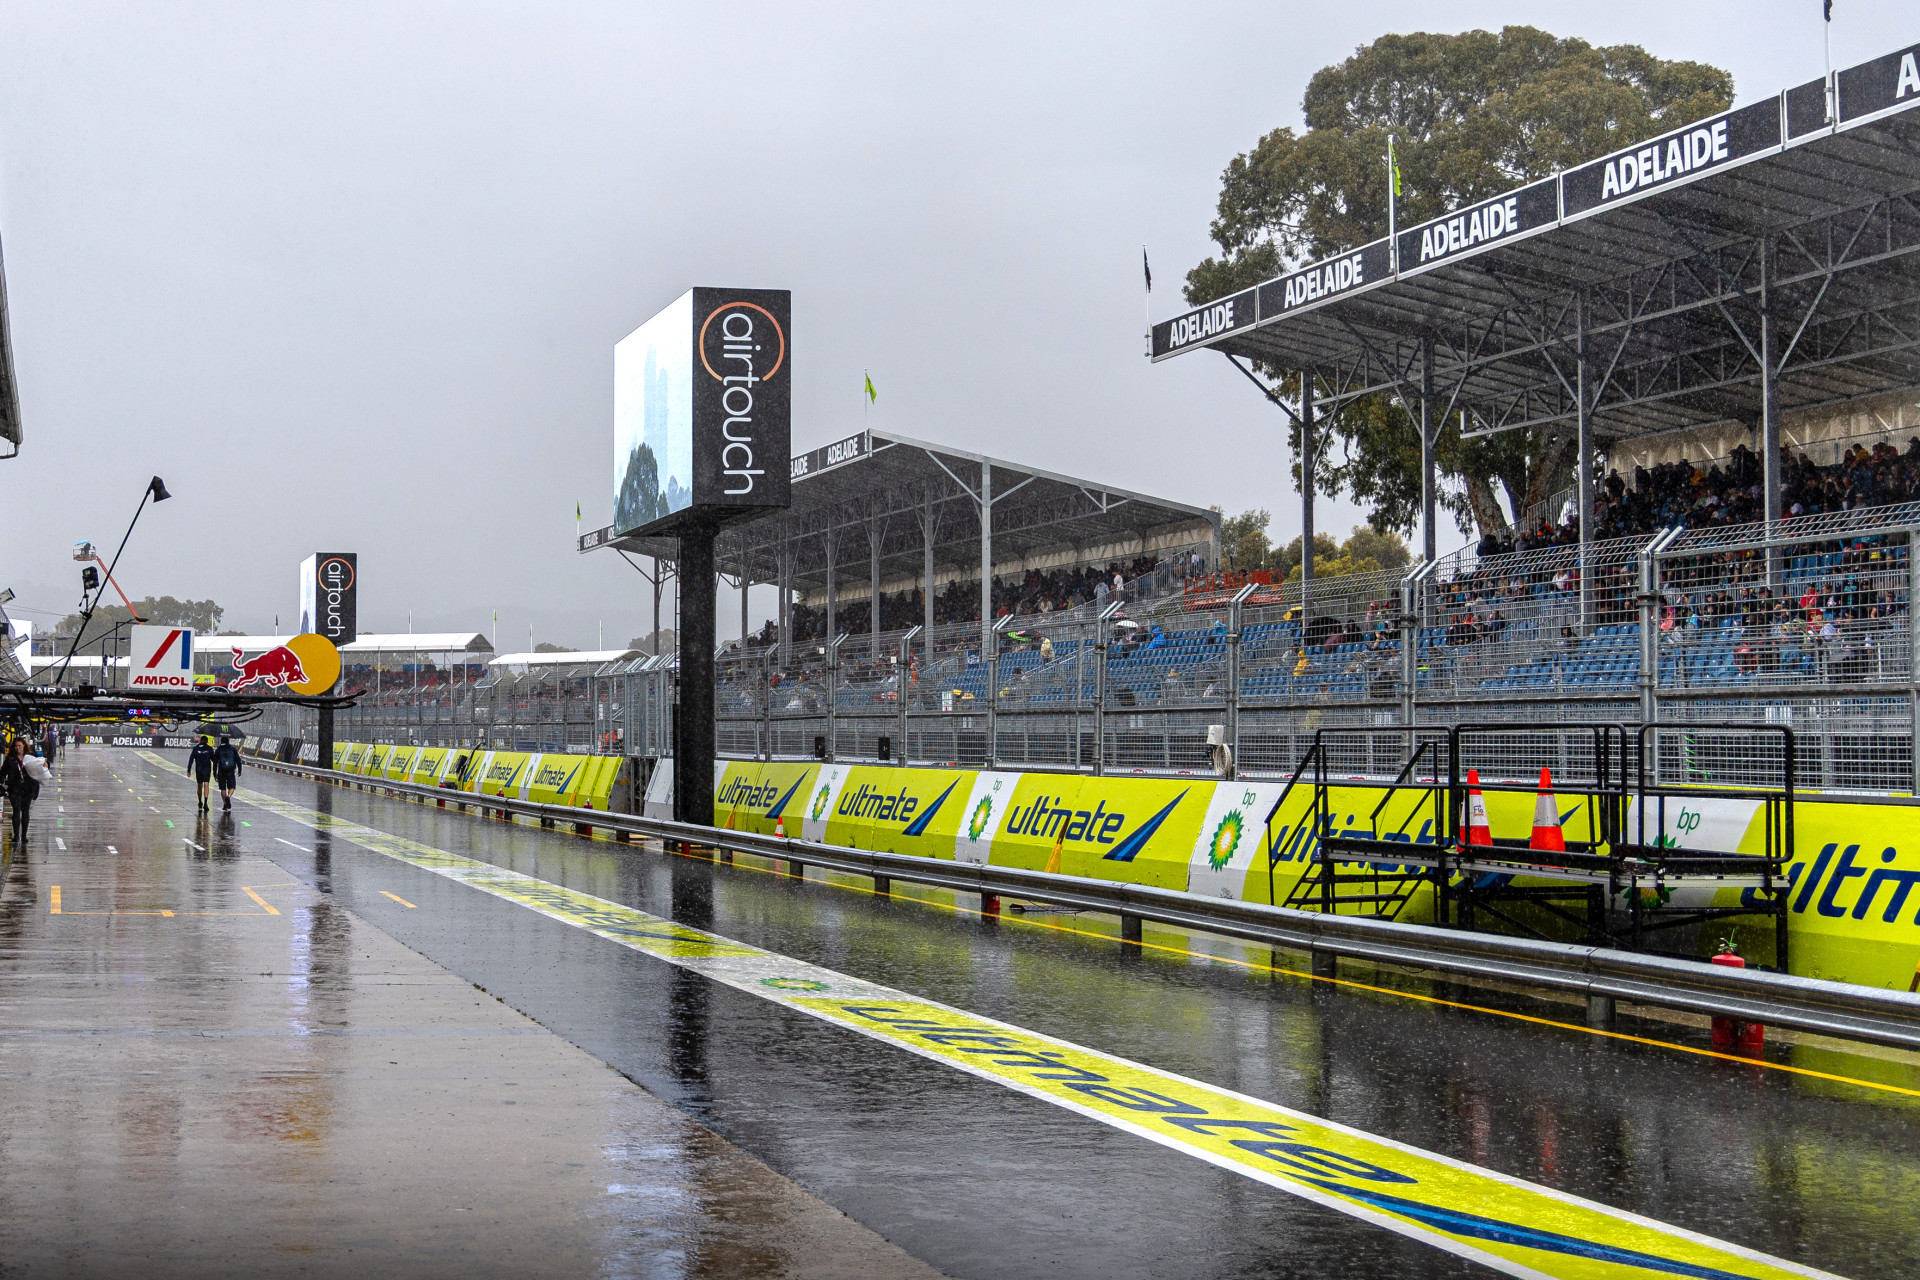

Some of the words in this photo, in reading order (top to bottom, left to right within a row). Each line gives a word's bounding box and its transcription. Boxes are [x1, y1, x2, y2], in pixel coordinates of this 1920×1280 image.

[1602, 120, 1728, 200] ADELAIDE
[1421, 198, 1518, 262] ADELAIDE
[1284, 253, 1363, 309] ADELAIDE
[1169, 300, 1234, 348] ADELAIDE
[722, 312, 765, 494] airtouch
[827, 437, 859, 466] ADELAIDE
[327, 562, 346, 636] airtouch
[133, 675, 189, 686] AMPOL
[128, 708, 150, 716] GROVE
[90, 736, 103, 744] RAA
[113, 736, 153, 747] ADELAIDE
[165, 737, 192, 747] ADELAIDE
[487, 761, 513, 781] ultimate
[534, 764, 566, 787] ultimate
[831, 768, 839, 780] bp
[993, 777, 1003, 791] bp
[717, 776, 778, 808] ultimate
[838, 783, 919, 822] ultimate
[1242, 787, 1256, 809] bp
[1006, 795, 1125, 844] ultimate
[1676, 806, 1701, 836] bp
[840, 1004, 1419, 1185] ultimate
